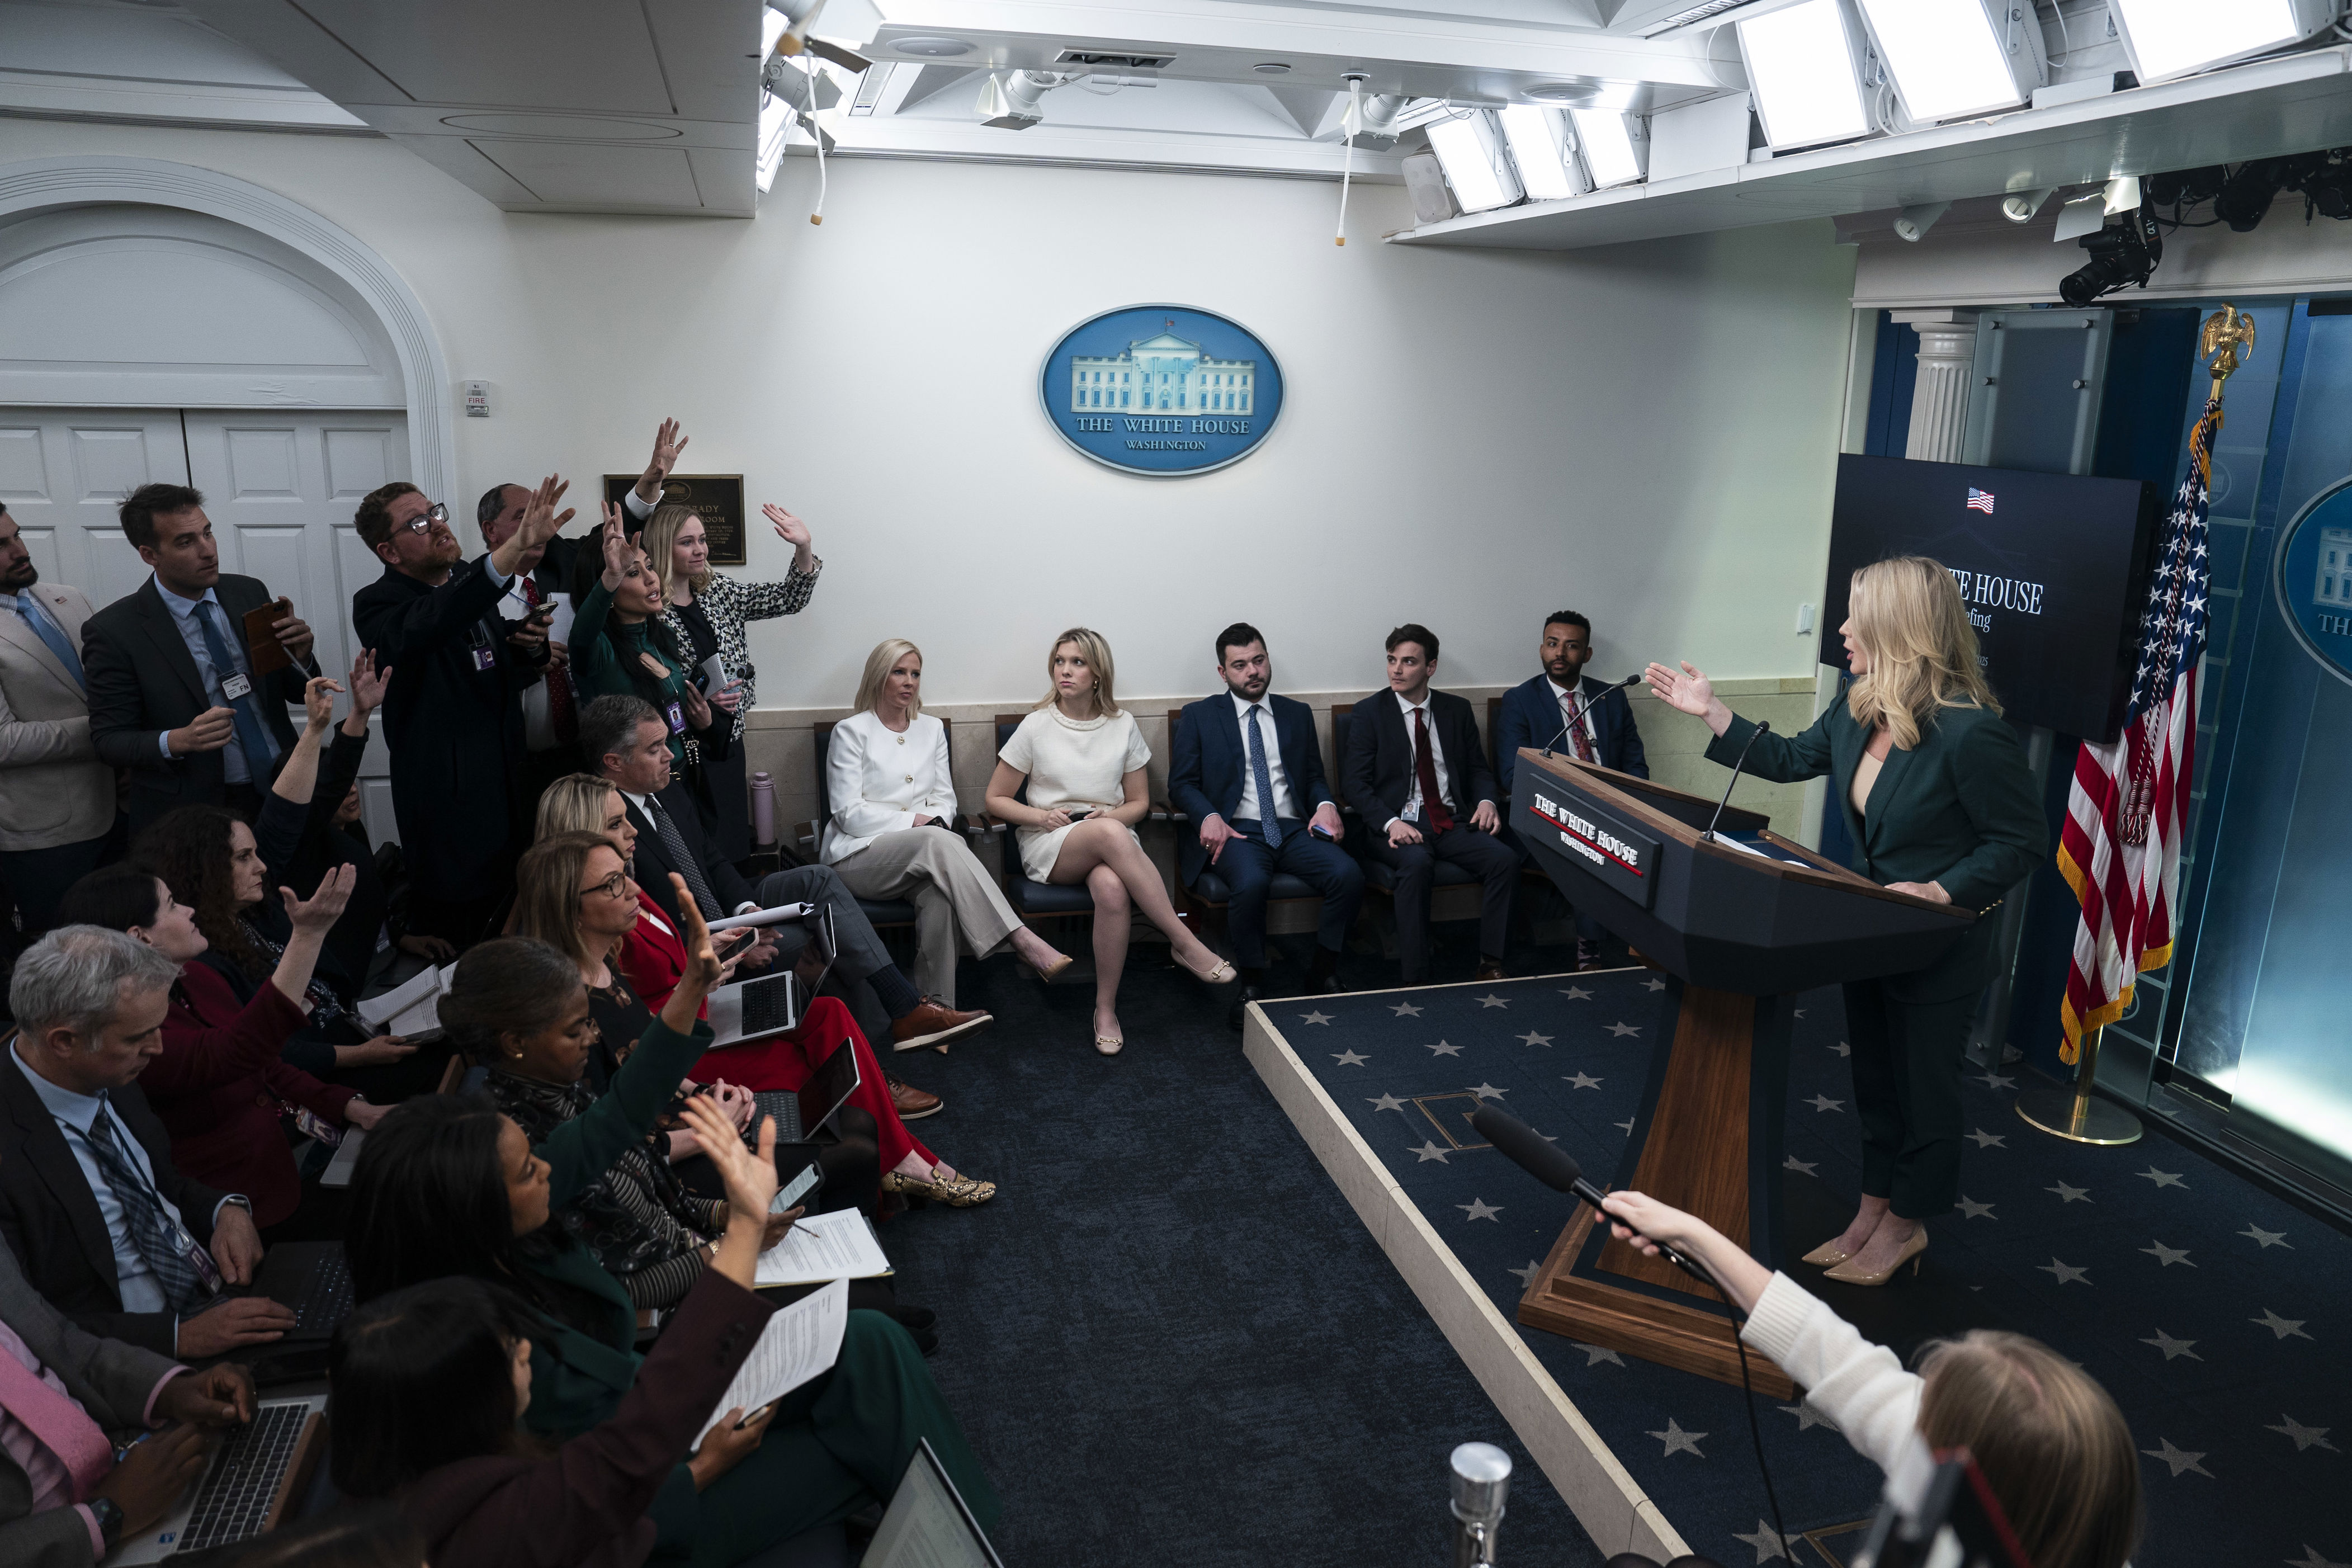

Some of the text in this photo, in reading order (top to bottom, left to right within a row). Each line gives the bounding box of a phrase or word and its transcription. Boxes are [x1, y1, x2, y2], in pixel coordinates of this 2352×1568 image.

[1076, 418, 1250, 434] THE WHITE HOUSE
[1126, 440, 1206, 450] WASHINGTON
[1973, 573, 2043, 615] HOUSE
[2318, 613, 2352, 636] TH
[1977, 655, 1989, 666] 025
[239, 683, 249, 692] FN
[1534, 793, 1638, 866] THE WHITE HOUSE
[1560, 831, 1605, 865] WASHINGTON
